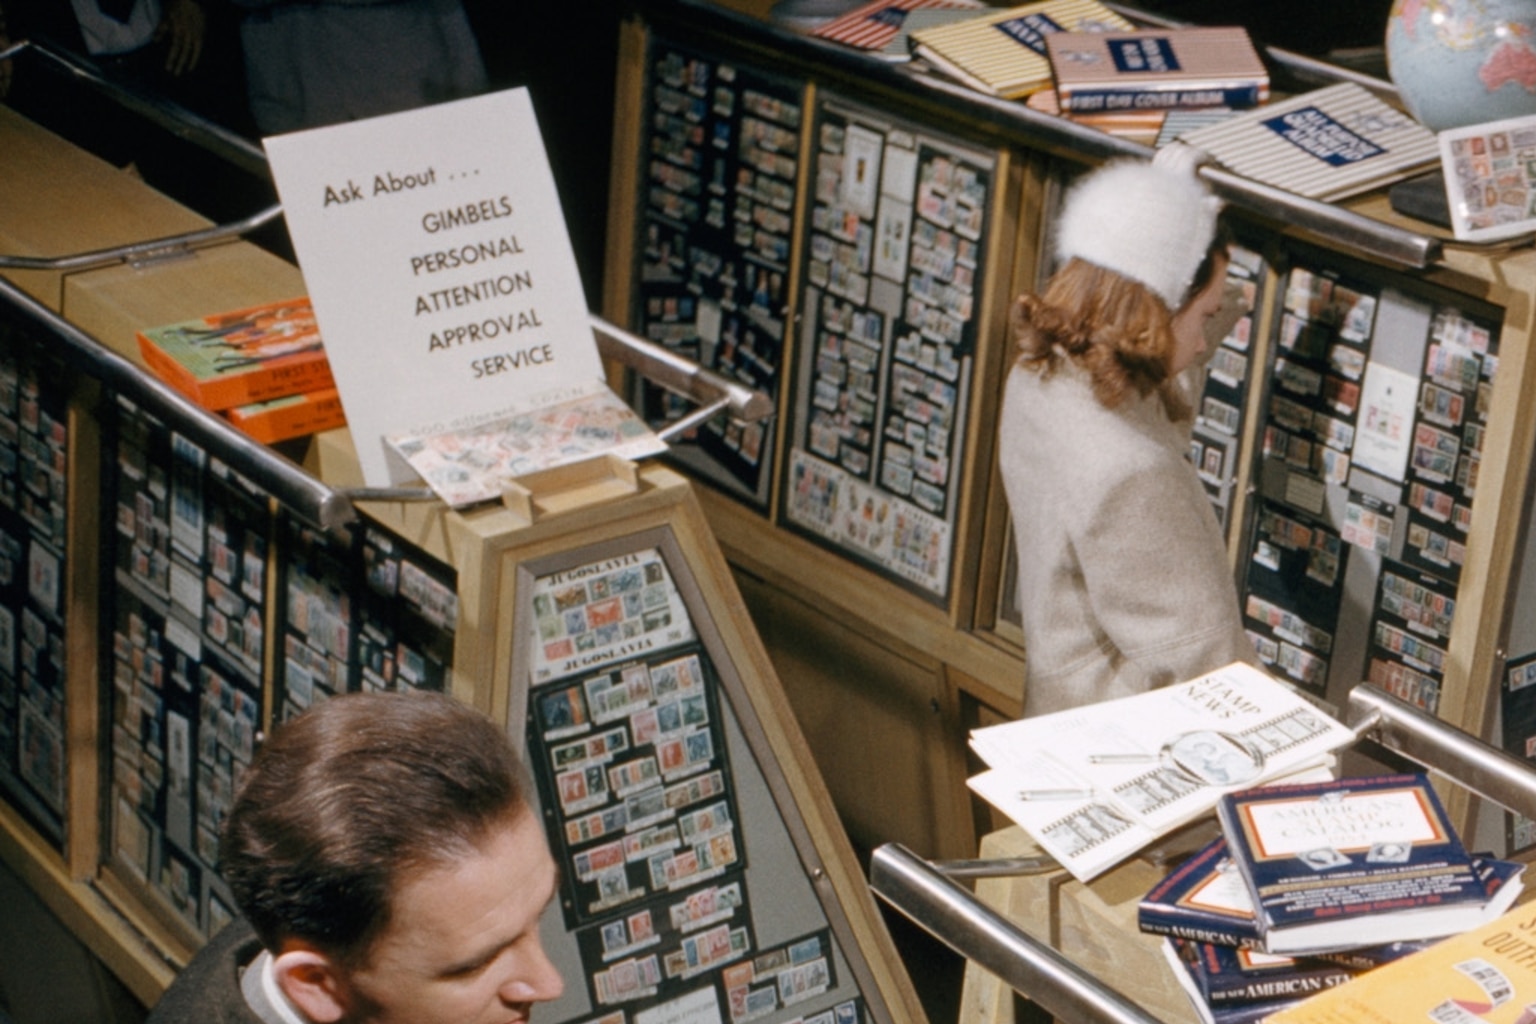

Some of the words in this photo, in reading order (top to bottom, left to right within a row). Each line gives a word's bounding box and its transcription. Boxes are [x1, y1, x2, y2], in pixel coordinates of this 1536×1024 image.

[1134, 92, 1177, 107] COVER
[323, 180, 363, 207] Ask
[372, 167, 436, 197] About
[422, 196, 513, 234] GIMBELS
[410, 235, 524, 276] PERSONAL
[414, 271, 533, 316] ATTENTION
[428, 308, 542, 352] APPROVAL
[471, 344, 554, 379] SERVICE
[549, 554, 639, 586] JUGOSLAVIA
[564, 639, 653, 671] JUGOSLAVIA
[1183, 684, 1235, 720] NEWS
[1202, 676, 1263, 716] STAMP
[1171, 925, 1238, 947] AMERICAN
[1240, 937, 1266, 951] STA
[1245, 976, 1321, 999] AMERICAN
[1324, 973, 1357, 988] STA
